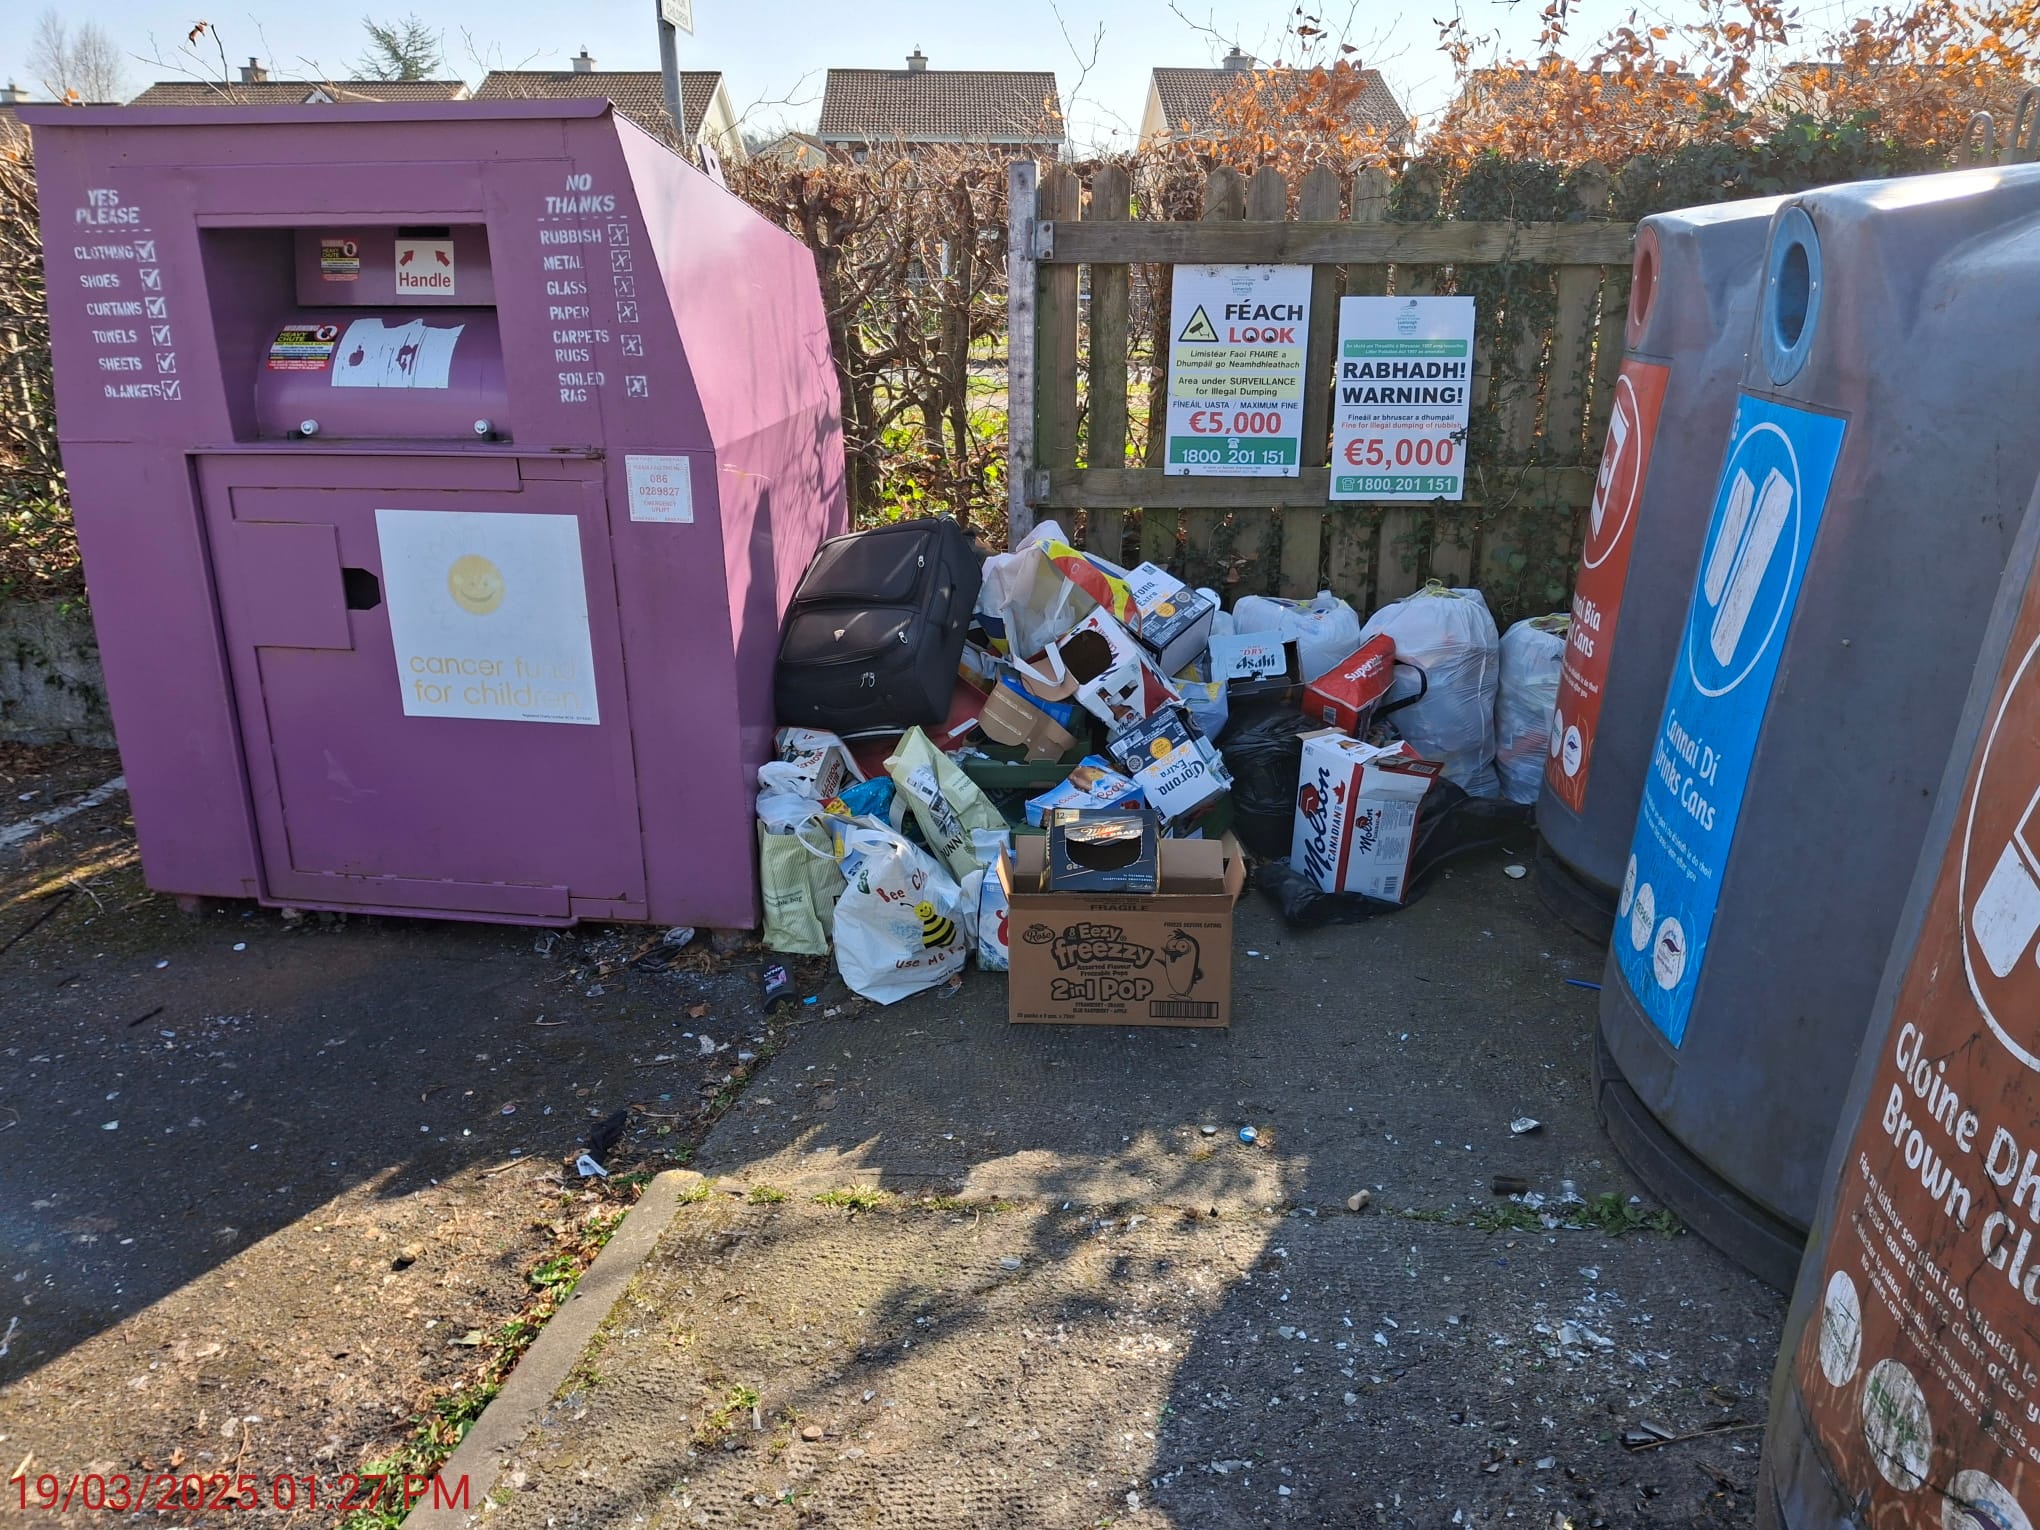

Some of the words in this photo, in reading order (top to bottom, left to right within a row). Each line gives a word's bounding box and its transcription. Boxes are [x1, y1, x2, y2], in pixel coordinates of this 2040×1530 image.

[566, 173, 592, 191] NO
[88, 189, 119, 206] YES
[545, 195, 615, 214] THANKS
[75, 207, 140, 225] PLEASE
[540, 229, 601, 245] RUBBISH
[74, 246, 134, 260] CLOTHING
[543, 256, 584, 271] METAL
[80, 274, 120, 288] SHOES
[399, 272, 451, 288] Handle
[546, 281, 587, 296] GLASS
[87, 302, 142, 316] CURTAINS
[549, 306, 590, 321] PAPER
[1225, 299, 1303, 321] FÉACH
[92, 329, 137, 344] TOWELS
[553, 330, 610, 344] CARPETS
[1229, 327, 1295, 344] LOOK
[555, 349, 590, 363] RUGS
[1229, 350, 1248, 358] Faoi
[1249, 350, 1279, 359] FHAIRE
[98, 356, 143, 371] SHEETS
[1176, 360, 1213, 369] Dhumpáil
[1215, 361, 1226, 369] go
[1229, 360, 1300, 369] Neamhdhleathach
[1343, 362, 1466, 379] RABHADH!
[1178, 377, 1198, 385] Area
[1201, 377, 1226, 385] under
[1230, 377, 1296, 386] SURVEILLANCE
[104, 384, 161, 398] BLANKETS
[560, 389, 587, 403] RAG
[1211, 388, 1237, 397] Illegal
[1240, 388, 1278, 398] Dumping
[1342, 387, 1464, 404] WARNING!
[1204, 401, 1230, 409] UASTA
[1281, 402, 1299, 410] FINE
[1189, 411, 1282, 434] €5,000
[1370, 422, 1391, 430] illegal
[1393, 422, 1424, 430] dumping
[1182, 449, 1221, 464] 1800
[1228, 450, 1255, 464] 201
[1262, 450, 1284, 464] 151
[1344, 439, 1454, 470] €5,000
[650, 474, 668, 483] 086
[1356, 479, 1391, 491] 1800
[1396, 479, 1421, 491] 201
[1428, 479, 1451, 491] 151
[640, 487, 680, 496] 0289827
[1584, 600, 1601, 632] Bia
[1573, 623, 1595, 658] Cans
[409, 655, 503, 676] cancer
[1236, 654, 1275, 669] Asahi
[414, 680, 452, 704] for
[1666, 708, 1703, 769] Cannaí
[1699, 745, 1721, 787] Dí
[1160, 760, 1188, 778] Extra
[1158, 760, 1205, 796] Corona
[1655, 737, 1682, 796] Drinks
[1681, 777, 1716, 831] Cans
[1303, 766, 1332, 892] Molson
[1327, 811, 1342, 862] CANADIAN
[1360, 808, 1376, 855] Molson
[876, 887, 906, 903] Bee
[1078, 923, 1122, 941] Eezy
[1052, 938, 1154, 970] freezzy
[763, 966, 784, 978] LYNX
[1100, 977, 1153, 1000] POP
[1896, 1022, 1979, 1153] Gloine
[1882, 1083, 1972, 1232] Brown
[1859, 1151, 1870, 1180] Fág
[1877, 1184, 1903, 1230] láthair
[1901, 1227, 1917, 1252] seo
[1942, 1276, 1949, 1292] i
[1949, 1286, 1965, 1310] do
[2022, 1362, 2038, 1388] le
[1863, 1192, 1885, 1235] Please
[1884, 1227, 1905, 1267] leave
[1906, 1261, 1925, 1293] this
[1951, 1321, 1986, 1364] clean
[1987, 1363, 2025, 1402] after
[1860, 1253, 1869, 1272] No
[1936, 1365, 1948, 1380] or
[1947, 1379, 1976, 1416] pyrex
